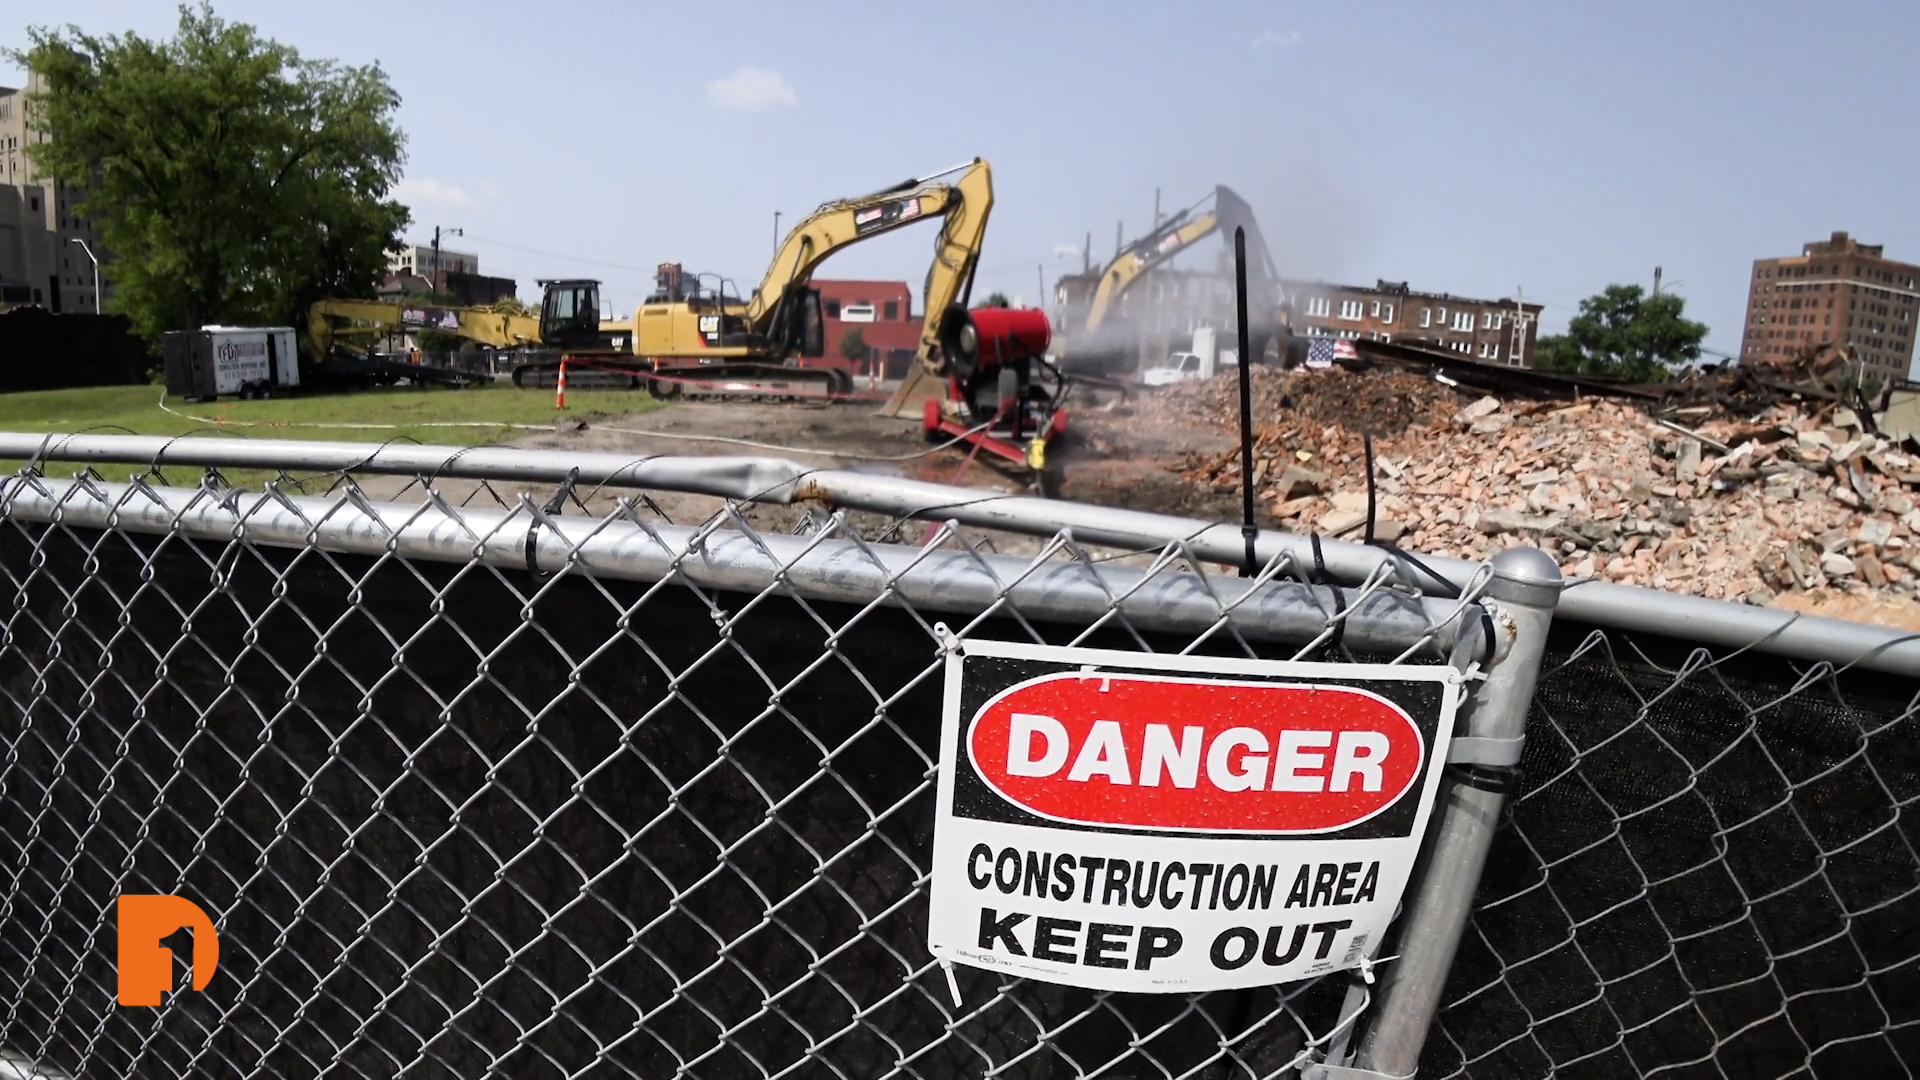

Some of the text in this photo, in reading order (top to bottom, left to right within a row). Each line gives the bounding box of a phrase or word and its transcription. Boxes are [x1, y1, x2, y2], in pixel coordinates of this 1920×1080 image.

[700, 316, 719, 332] CAT
[1006, 712, 1390, 793] DANGER
[967, 843, 1381, 911] CONSTRUCTION AREA
[977, 907, 1354, 971] KEEP OUT
